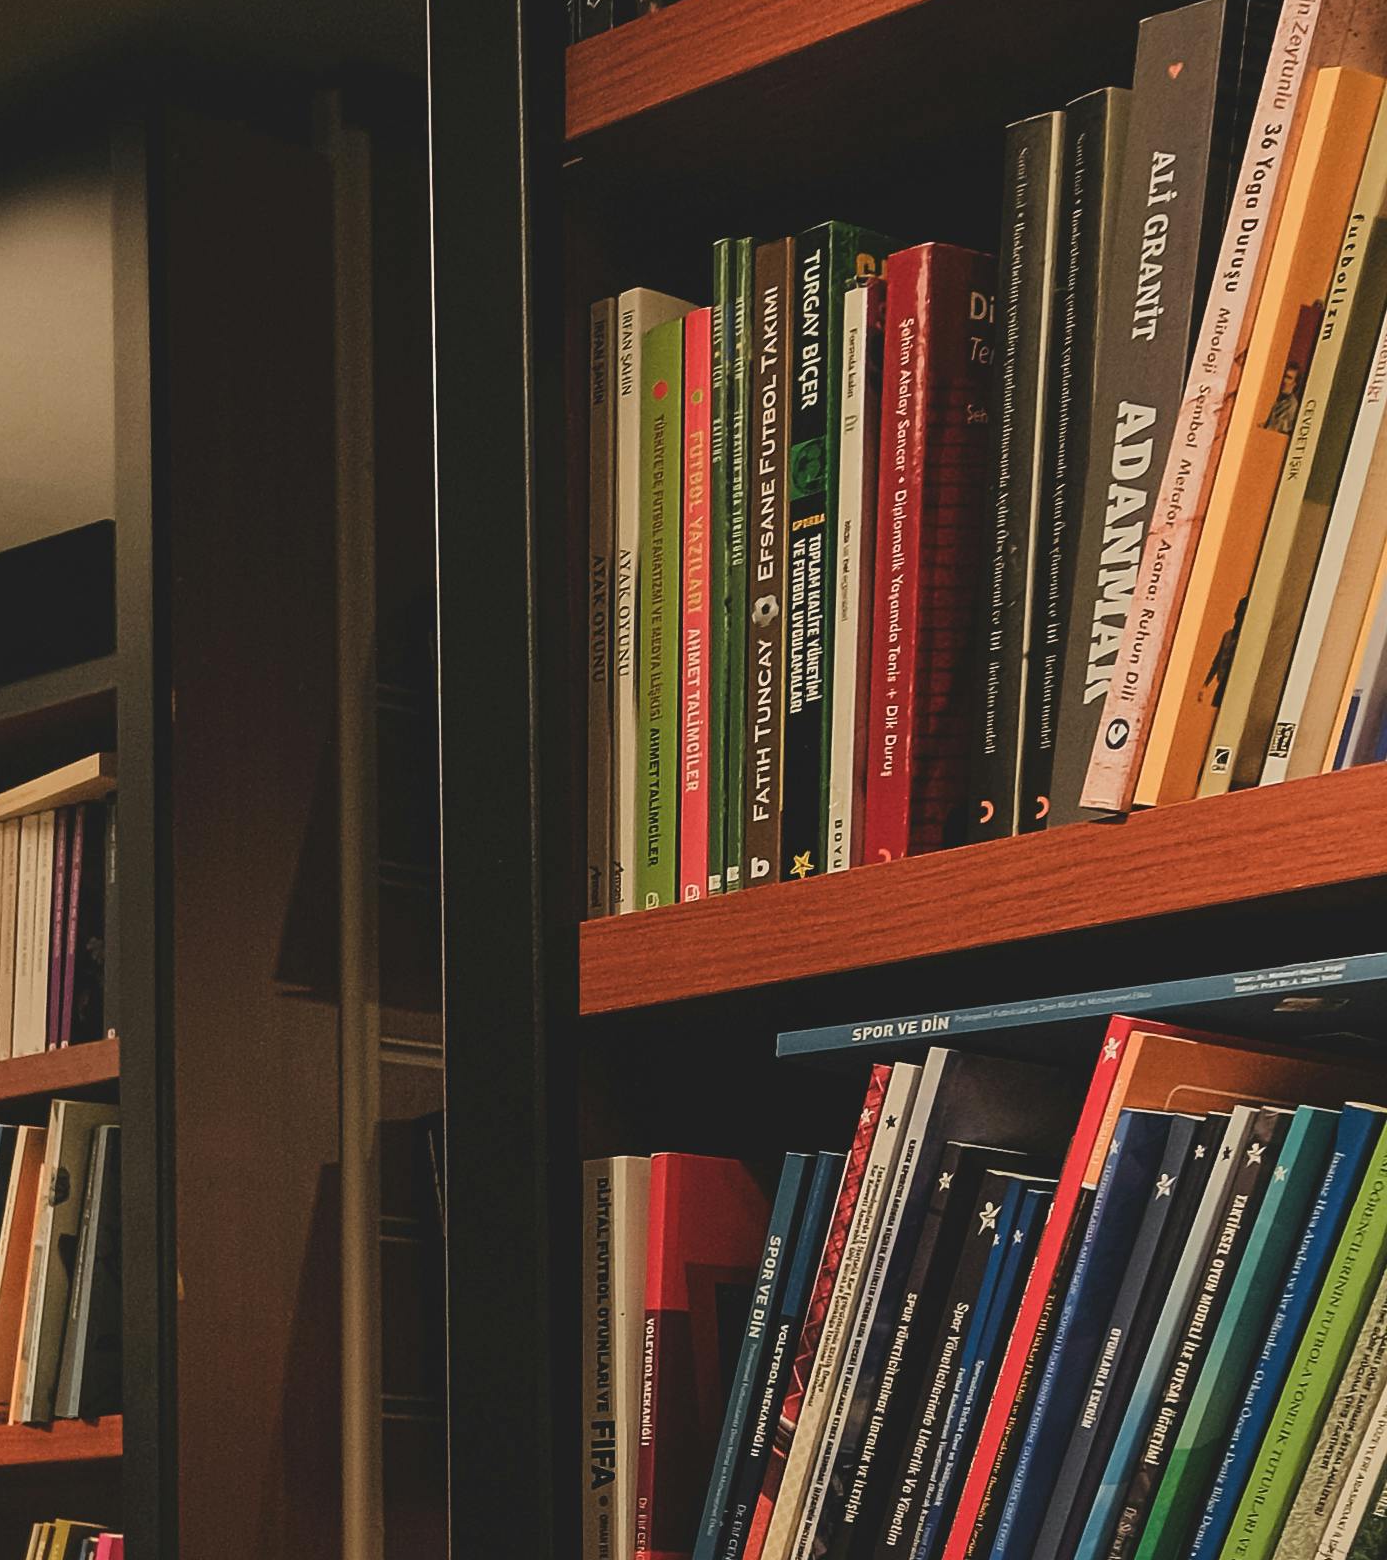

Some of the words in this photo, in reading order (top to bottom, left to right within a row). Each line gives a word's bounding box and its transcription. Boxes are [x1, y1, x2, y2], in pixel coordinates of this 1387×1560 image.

[1272, 22, 1310, 111] Zeytunlu
[1260, 124, 1283, 151] 36
[1146, 151, 1178, 208] ALİ
[1244, 157, 1276, 209] Yoga
[1130, 213, 1171, 341] GRANİT
[1223, 218, 1259, 294] Duruşu
[1321, 213, 1365, 342] futbolizm
[800, 249, 821, 337] TURGAY
[761, 287, 778, 372] TAKIMI
[1202, 308, 1231, 374] Mitoloji
[797, 343, 821, 411] BİÇER
[759, 375, 777, 476] FUTBOL
[1185, 384, 1213, 449] Sembol
[1291, 399, 1317, 455] CEVDET
[688, 431, 704, 512] FUTBOL
[1164, 458, 1193, 529] Metafor
[757, 482, 775, 581] EFSANE
[1146, 539, 1173, 602] Asana:
[686, 629, 702, 688] AHMET
[1130, 608, 1155, 665] Ruhun
[754, 640, 773, 743] TUNCAY
[1119, 671, 1141, 702] Dili
[596, 1241, 612, 1305] FUTBOL
[761, 1235, 782, 1280] SPOR
[747, 1308, 767, 1339] DİN
[755, 1284, 771, 1305] VE
[596, 1391, 610, 1413] VE
[591, 1420, 617, 1491] FIFA
